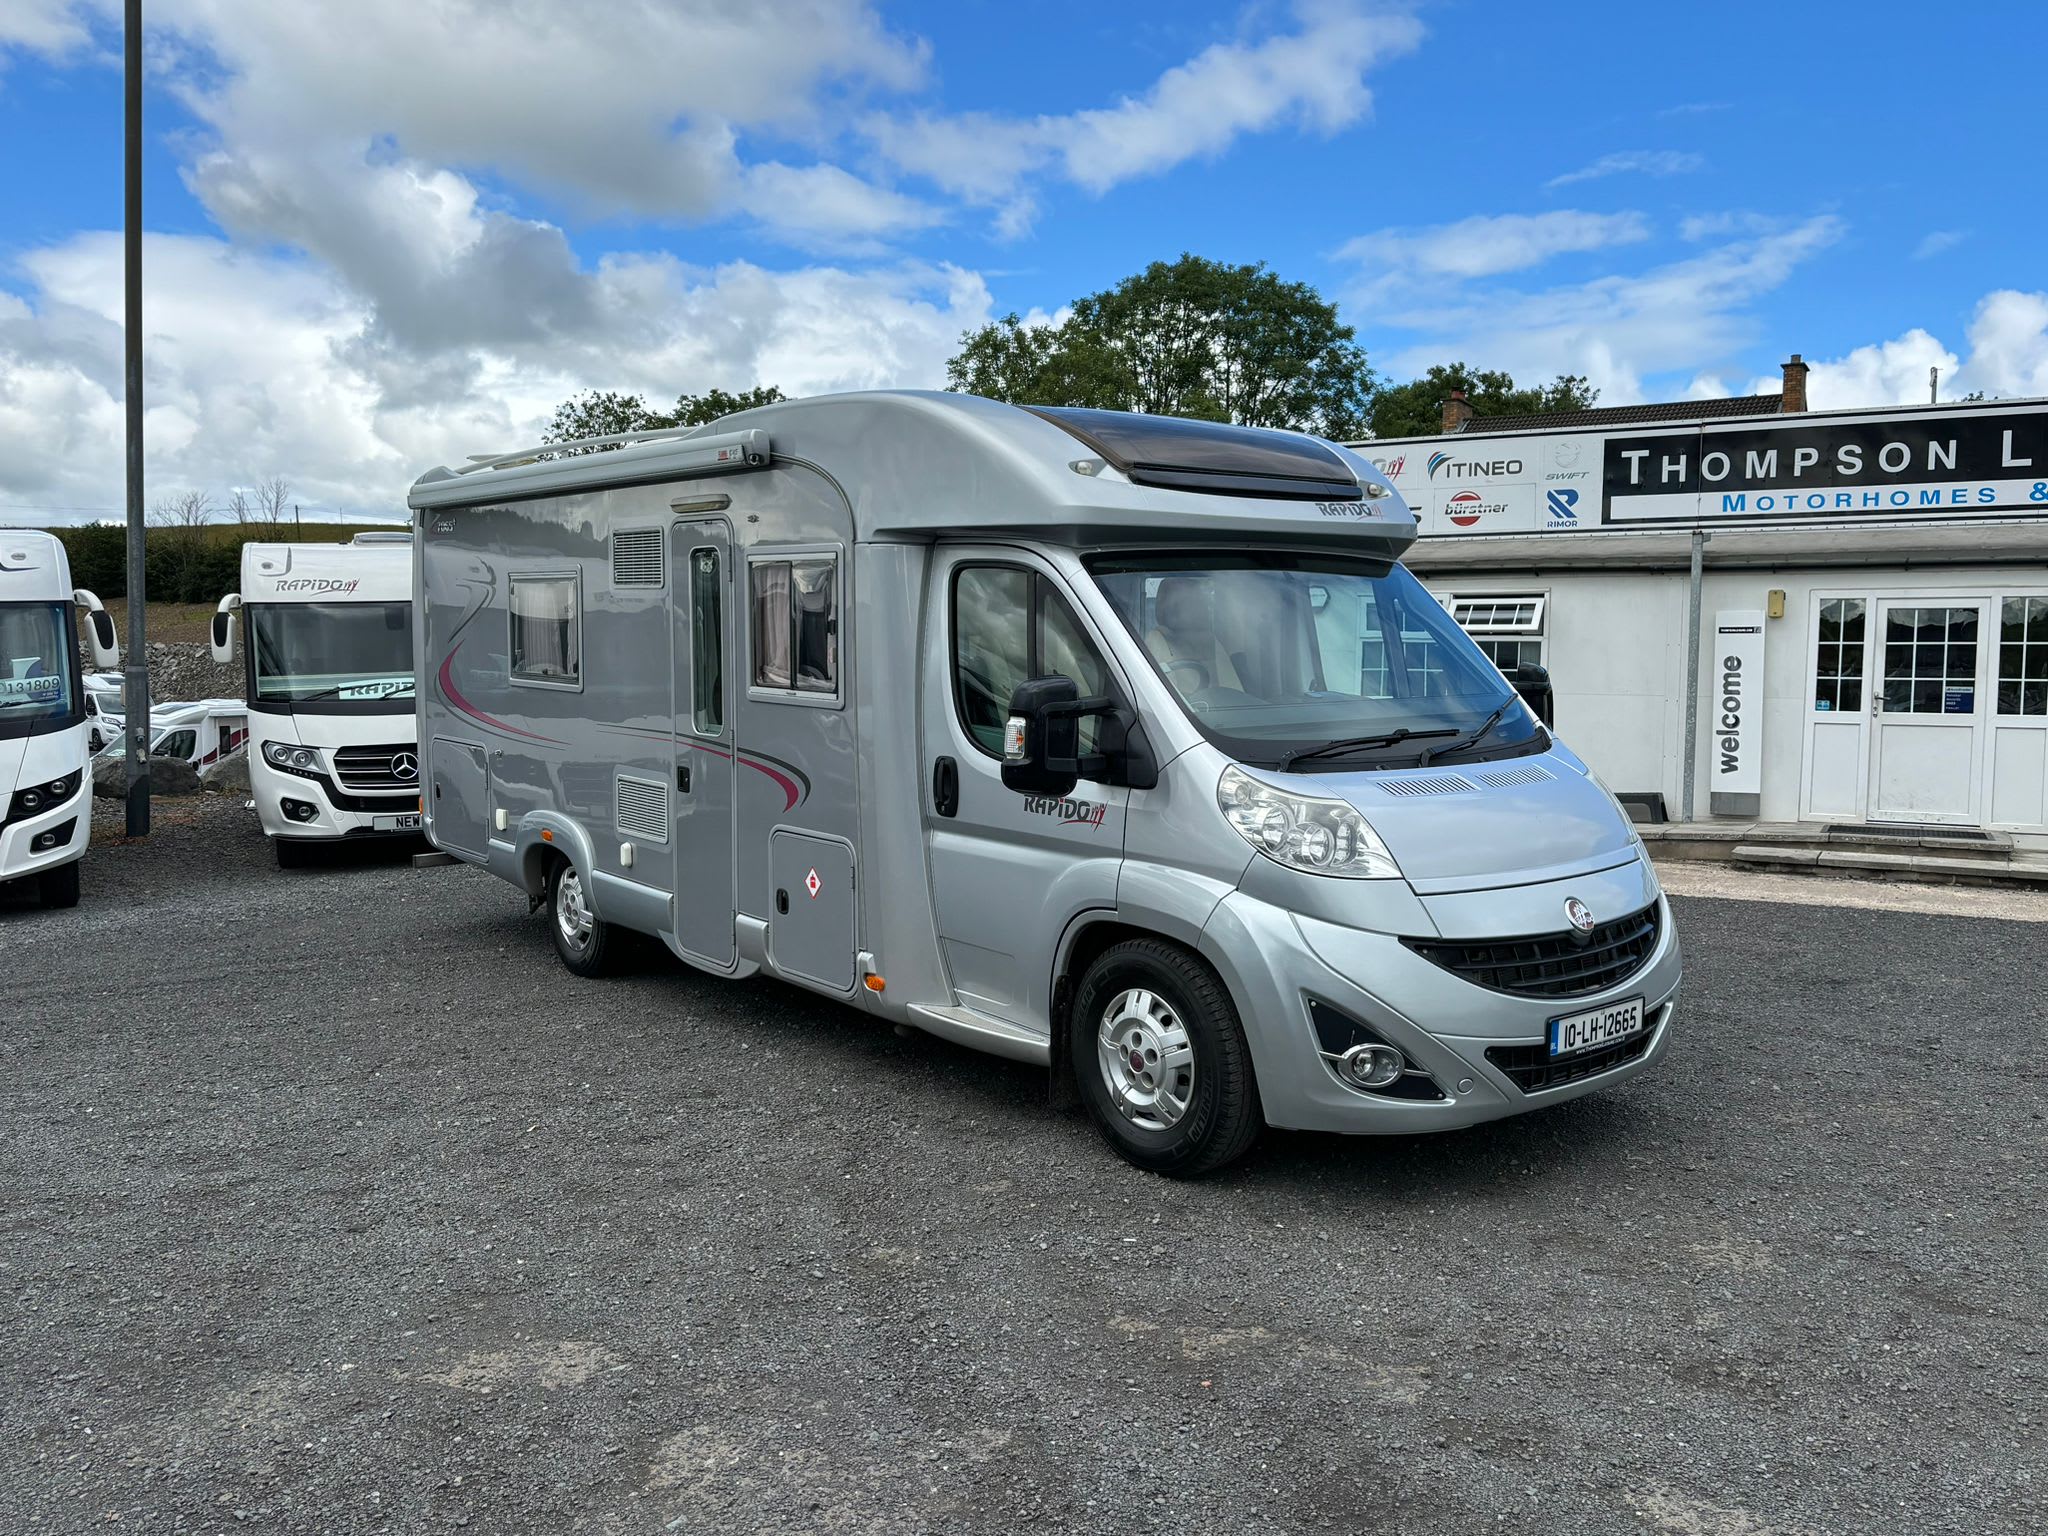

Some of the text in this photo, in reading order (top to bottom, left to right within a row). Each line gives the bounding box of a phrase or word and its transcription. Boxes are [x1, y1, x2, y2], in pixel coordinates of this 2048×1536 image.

[1446, 459, 1523, 479] ITINEO
[1621, 440, 1957, 484] THOMPSON
[1545, 471, 1590, 481] SWIFT
[1722, 481, 2048, 513] MOTORHOMES &
[1444, 502, 1509, 516] bürstner
[1547, 520, 1578, 528] RIMOR
[1715, 655, 1742, 774] welcome
[395, 816, 420, 828] NEW
[1564, 1006, 1637, 1049] 10-LH-12665
